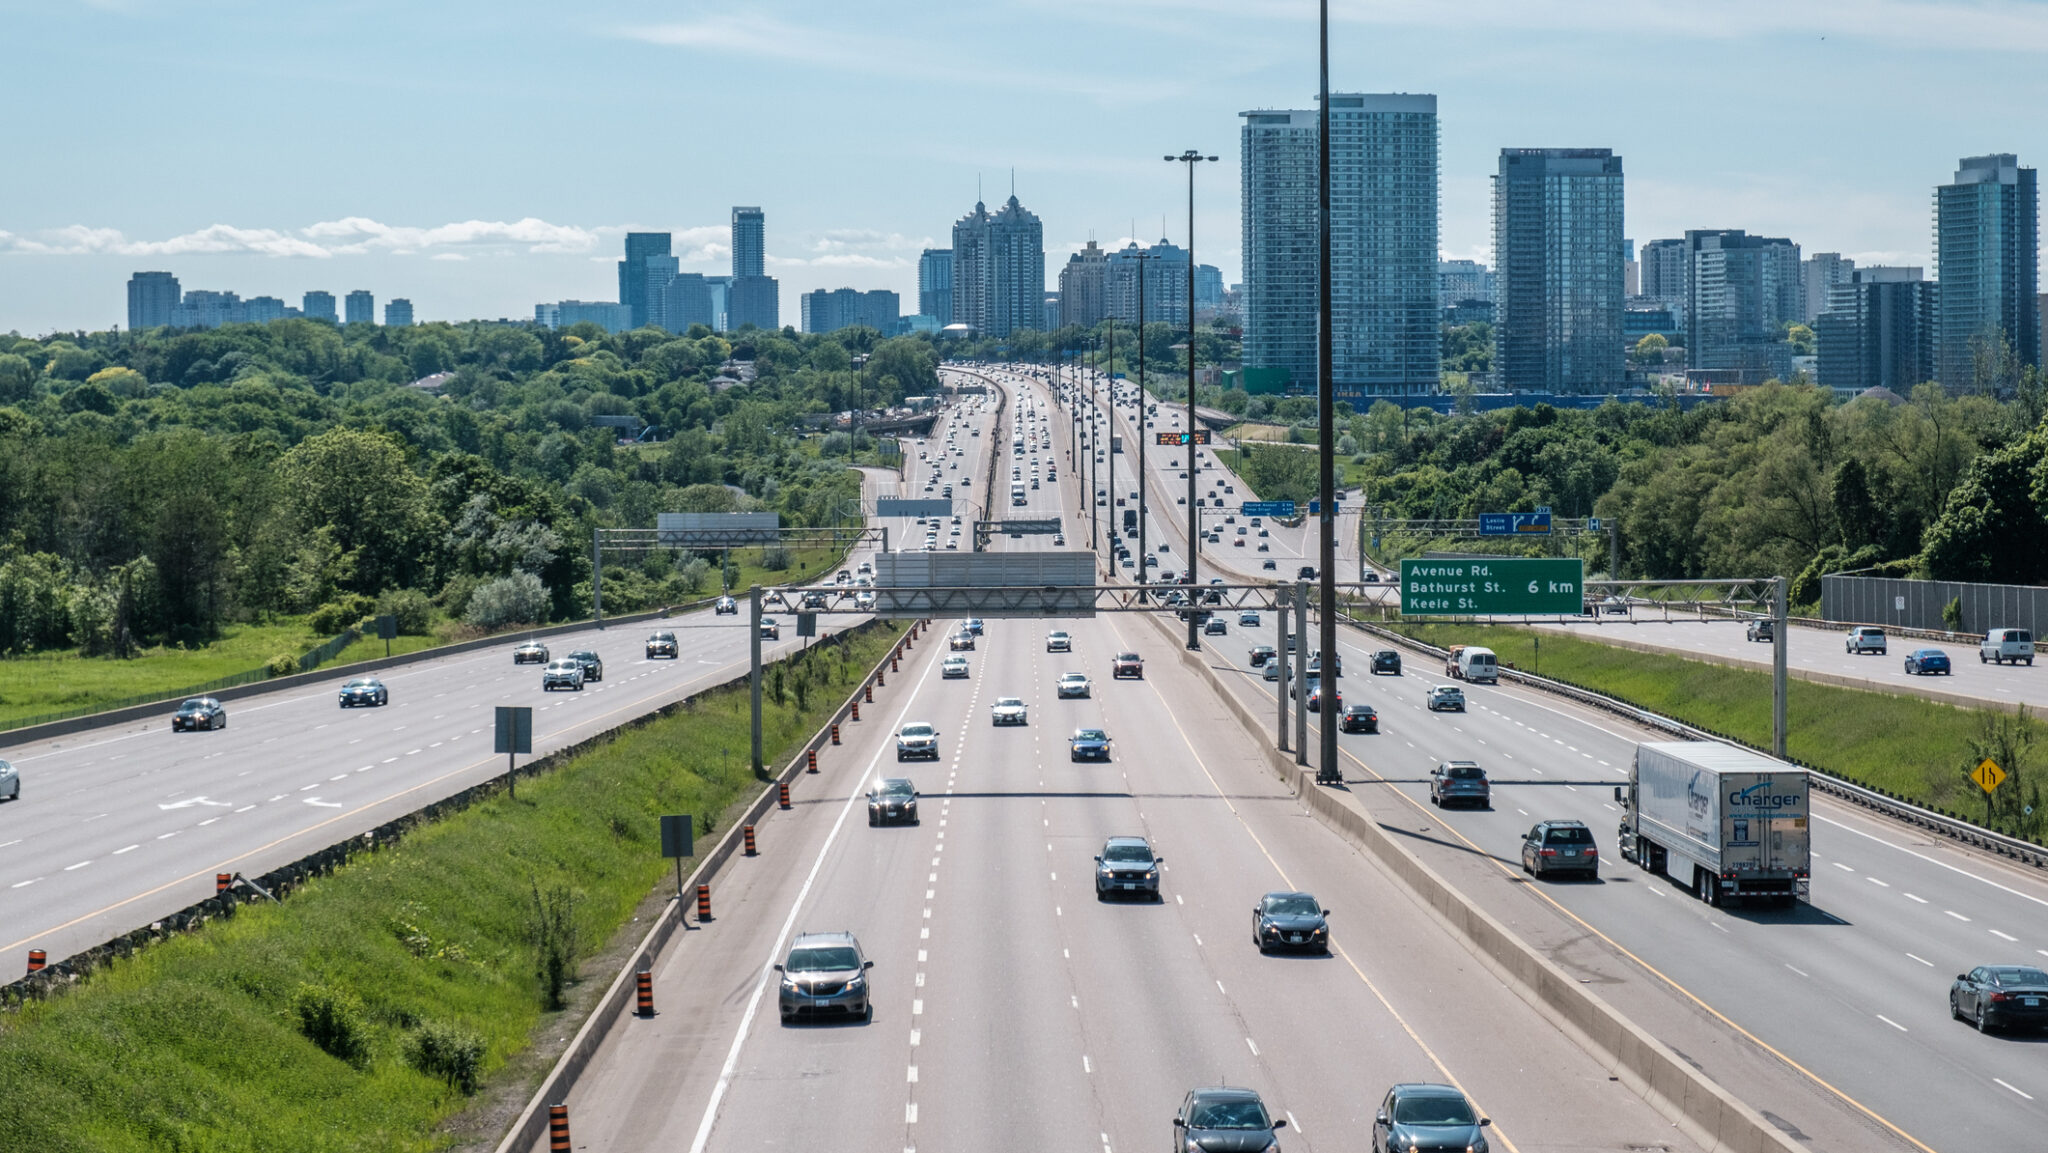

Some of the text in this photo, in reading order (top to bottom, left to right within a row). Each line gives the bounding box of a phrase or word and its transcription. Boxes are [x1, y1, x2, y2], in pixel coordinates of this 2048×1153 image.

[1410, 565, 1493, 577] Avenue Rd.
[1410, 581, 1506, 593] Bathurst St.
[1528, 580, 1574, 594] 6 km
[1410, 597, 1478, 609] Keele St.
[1729, 787, 1801, 810] Charger
